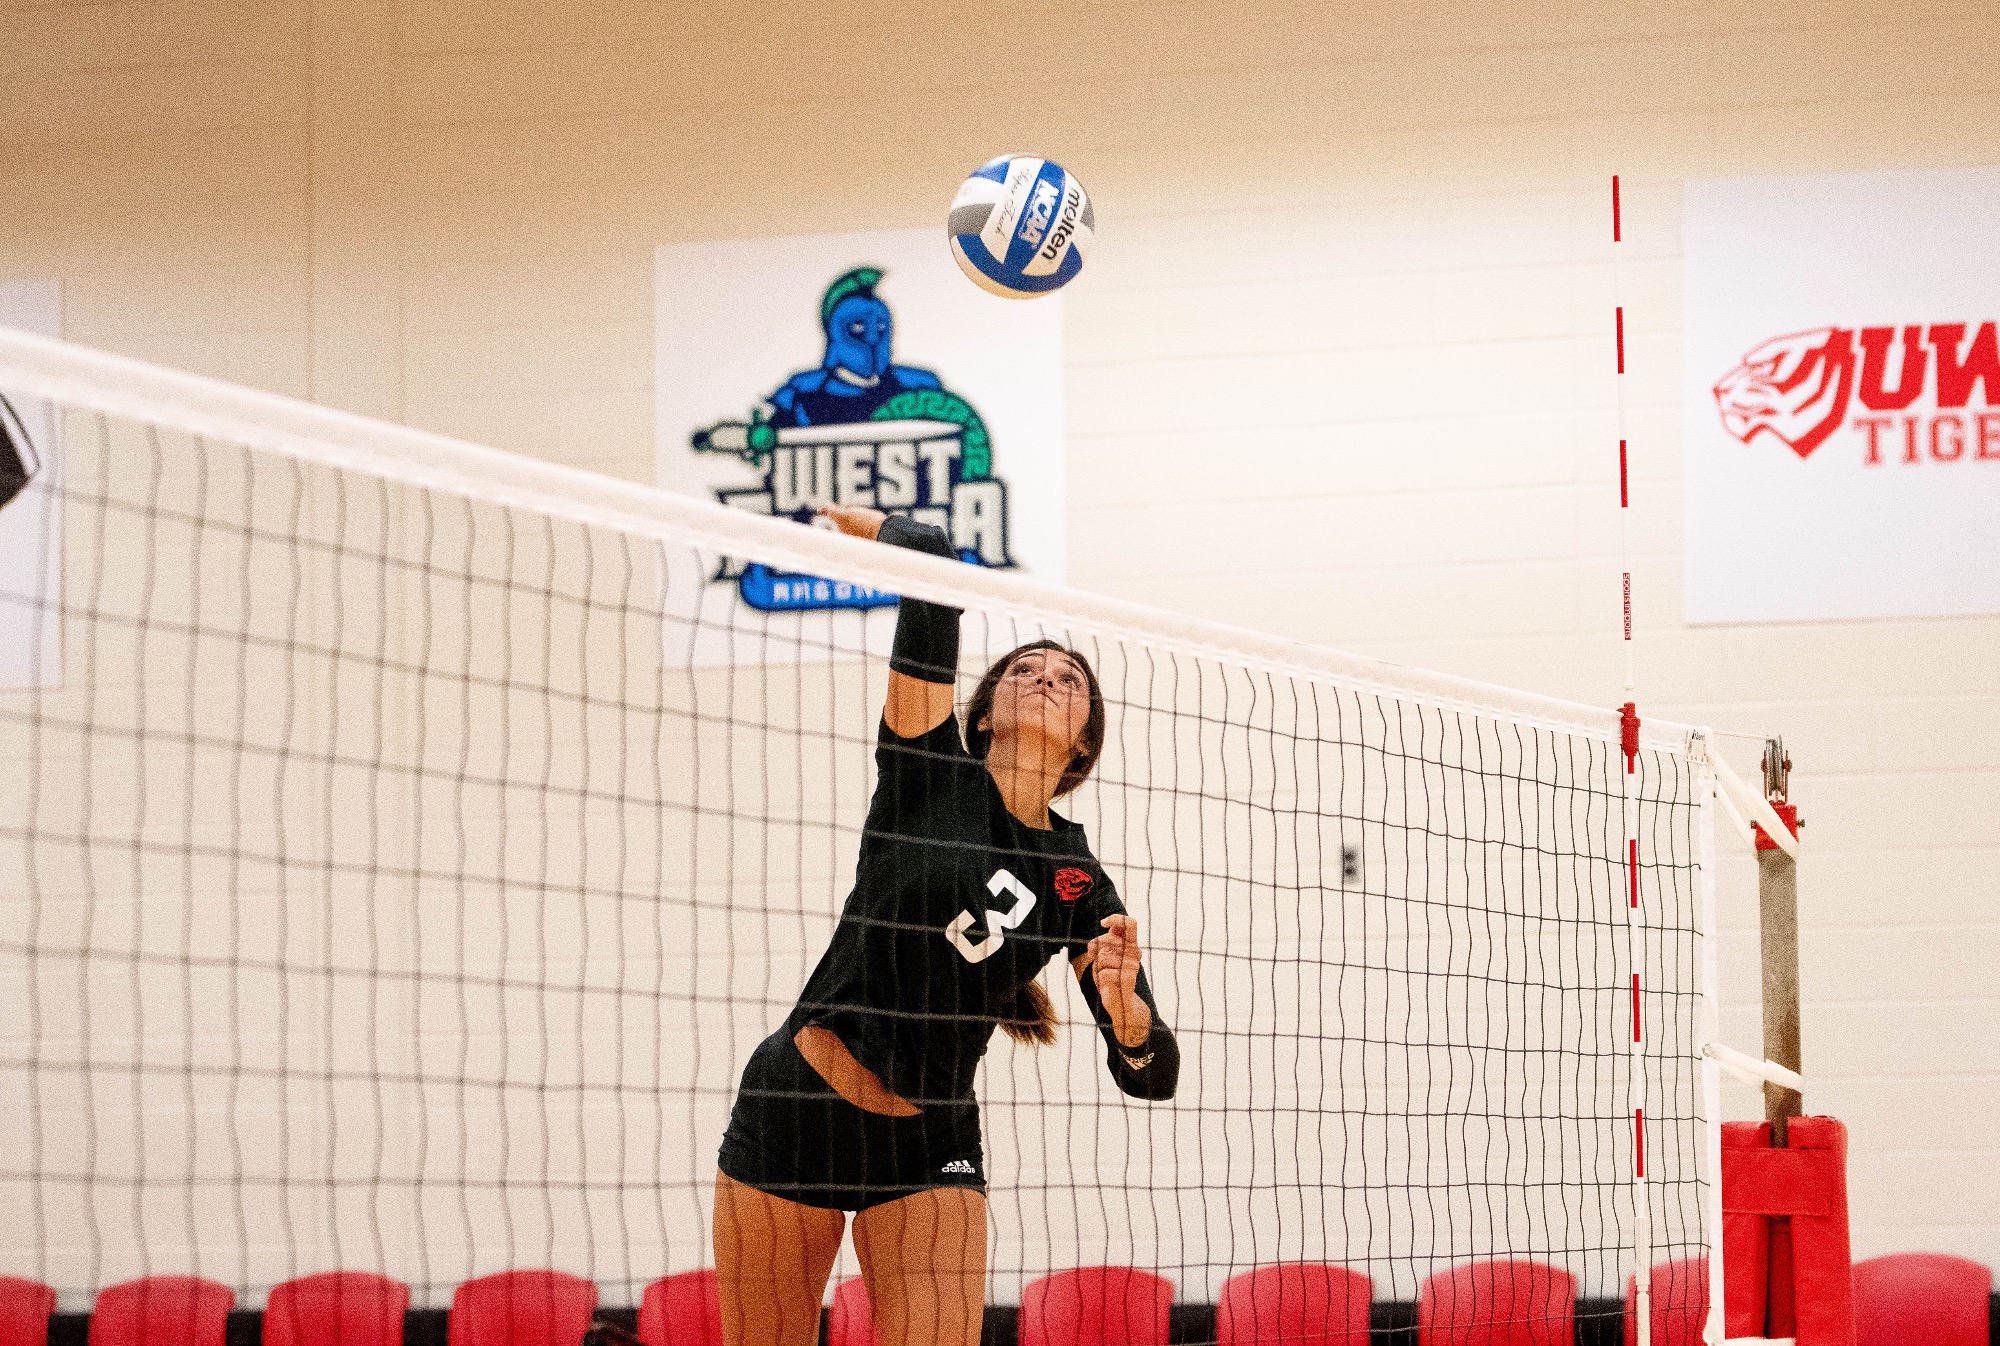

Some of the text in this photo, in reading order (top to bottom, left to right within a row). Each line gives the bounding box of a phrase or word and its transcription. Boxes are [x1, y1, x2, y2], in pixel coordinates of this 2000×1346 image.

[1019, 179, 1059, 249] NCAA
[1041, 187, 1080, 260] molten
[772, 438, 963, 513] WEST
[946, 868, 1037, 964] 3
[941, 1164, 976, 1174] adidas
